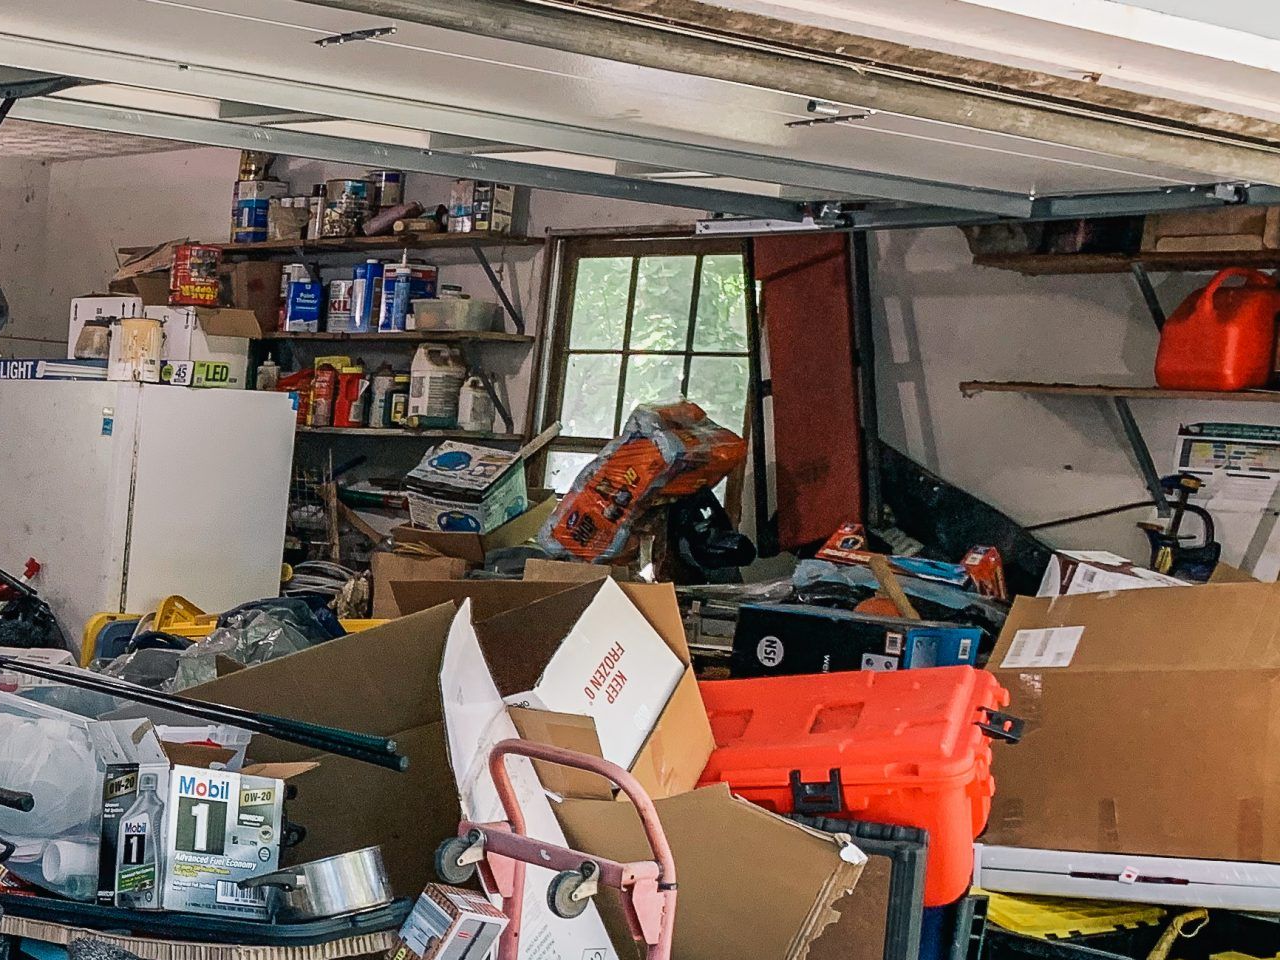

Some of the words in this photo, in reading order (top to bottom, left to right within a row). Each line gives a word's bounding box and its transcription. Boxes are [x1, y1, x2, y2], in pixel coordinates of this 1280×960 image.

[329, 300, 351, 312] KIL
[0, 361, 34, 380] LIGHT
[175, 367, 187, 379] 45
[205, 364, 229, 382] LED
[762, 639, 779, 665] NSF
[590, 641, 625, 691] FROZEN
[605, 670, 628, 705] KEEP
[179, 775, 230, 800] Mobil
[125, 822, 147, 834] Mobil
[191, 802, 210, 851] 1
[175, 852, 208, 864] Advanced
[210, 856, 225, 865] Fuel
[226, 857, 257, 871] Economy
